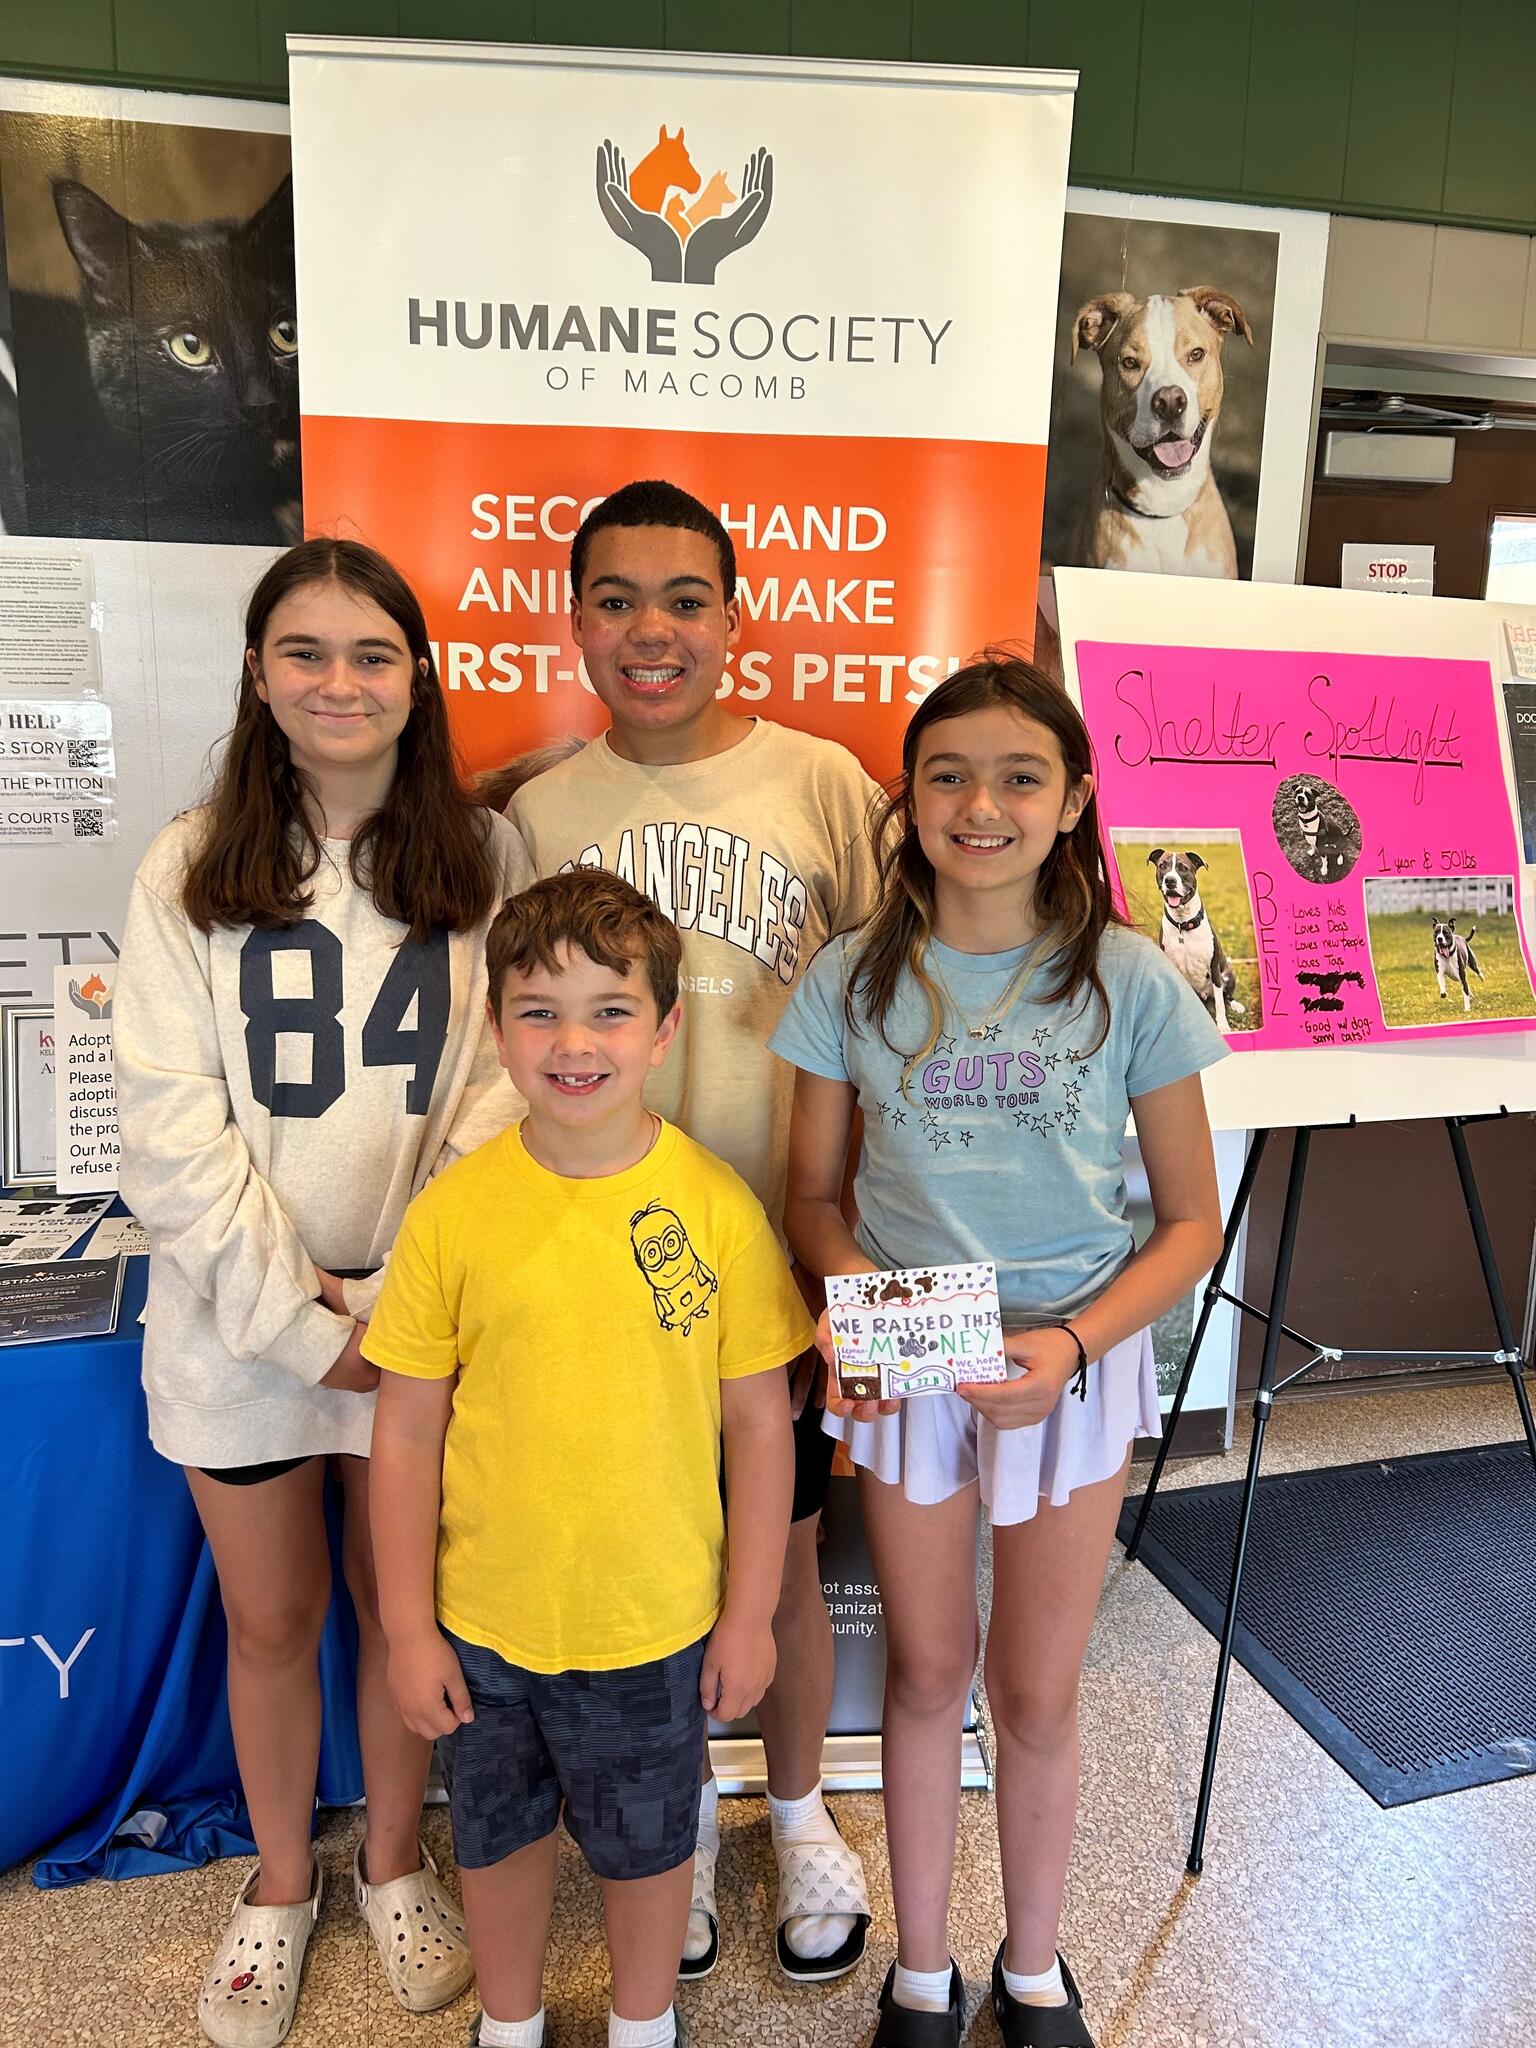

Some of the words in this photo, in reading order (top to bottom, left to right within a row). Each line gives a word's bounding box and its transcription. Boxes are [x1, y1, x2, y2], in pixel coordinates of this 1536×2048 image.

[409, 298, 676, 356] HUMANE
[693, 311, 953, 364] SOCIETY
[546, 366, 595, 391] OF
[625, 369, 806, 400] MACOMB
[1368, 563, 1407, 578] STOP
[736, 576, 895, 624] MAKE
[8, 714, 61, 729] HELP
[1114, 669, 1286, 767] Shelter
[1304, 675, 1462, 806] Spotlight
[11, 742, 64, 754] STORY
[1, 777, 30, 789] THE
[35, 777, 103, 789] PETITION
[8, 812, 70, 824] COURTS
[1378, 847, 1391, 872] 1
[1394, 858, 1416, 874] year
[1292, 903, 1321, 918] Loves
[1295, 922, 1320, 935] Loves
[1295, 940, 1318, 951] Loves
[1297, 956, 1320, 968] Loves
[239, 918, 451, 1119] 84
[1305, 1018, 1331, 1033] Good
[69, 1033, 111, 1048] Adopt
[69, 1050, 94, 1063] and
[98, 1053, 106, 1062] a
[70, 1071, 113, 1084] Please
[922, 1051, 1046, 1093] GUTS
[924, 1094, 988, 1109] WORLD
[995, 1092, 1040, 1108] TOUR
[70, 1123, 92, 1136] the
[97, 1124, 119, 1137] pro
[70, 1144, 96, 1157] Our
[100, 1142, 120, 1155] Ma
[71, 1161, 112, 1174] refuse
[832, 1319, 863, 1334] WE
[873, 1314, 953, 1334] RAISED
[961, 1311, 1001, 1328] THIS
[956, 1360, 973, 1368] We
[976, 1356, 999, 1365] hope
